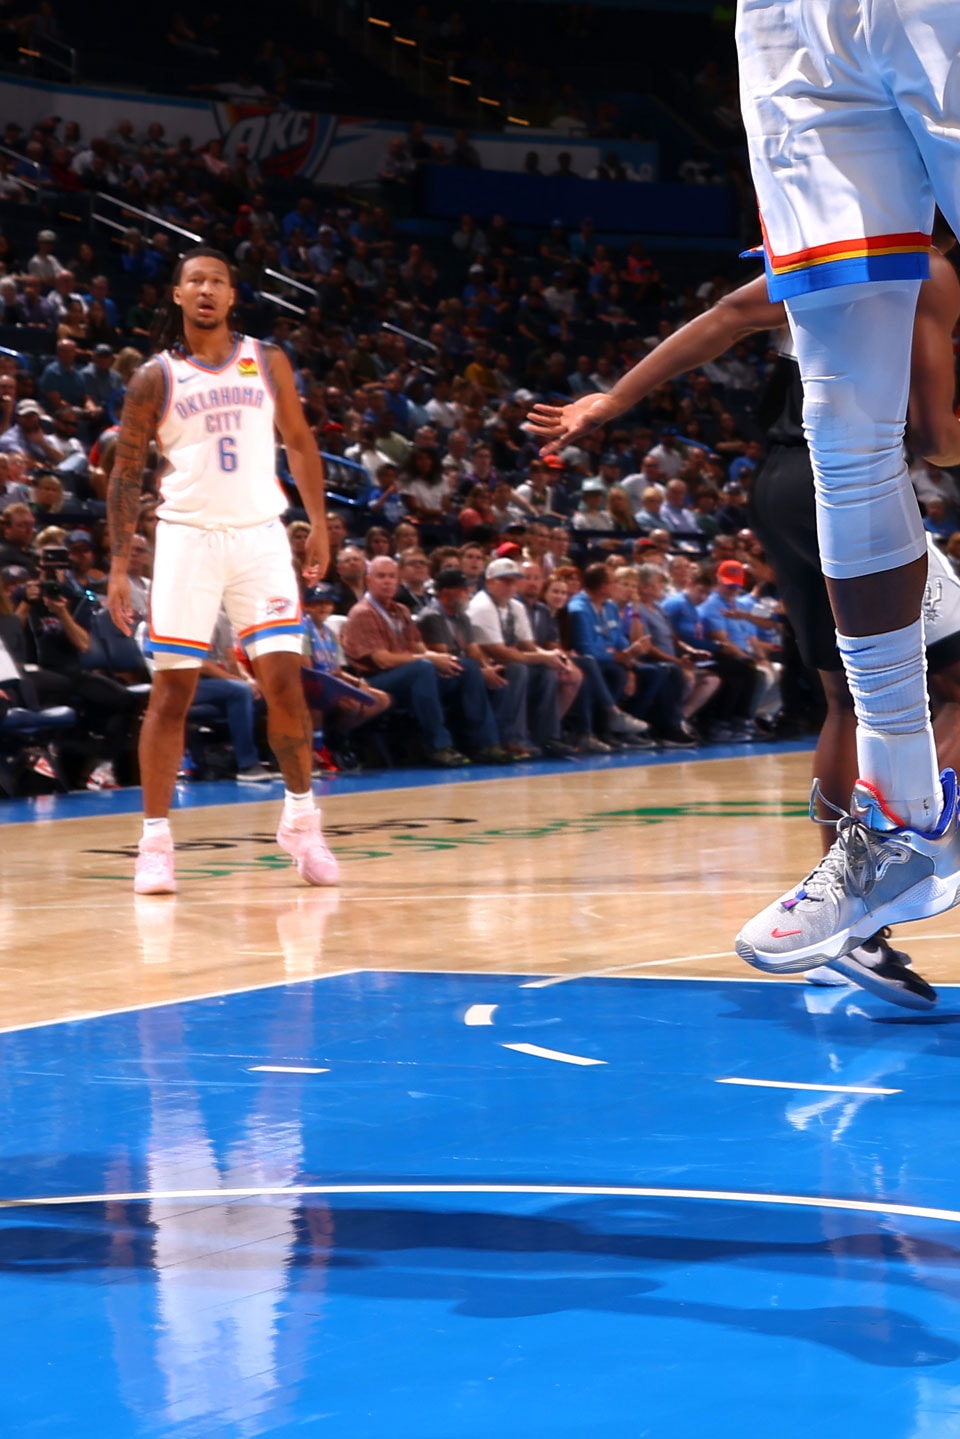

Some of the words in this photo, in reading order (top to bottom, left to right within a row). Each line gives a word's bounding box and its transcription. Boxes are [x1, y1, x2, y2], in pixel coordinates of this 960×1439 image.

[174, 386, 264, 420] OKLAHOMA
[204, 410, 242, 434] CITY
[217, 435, 239, 474] 6
